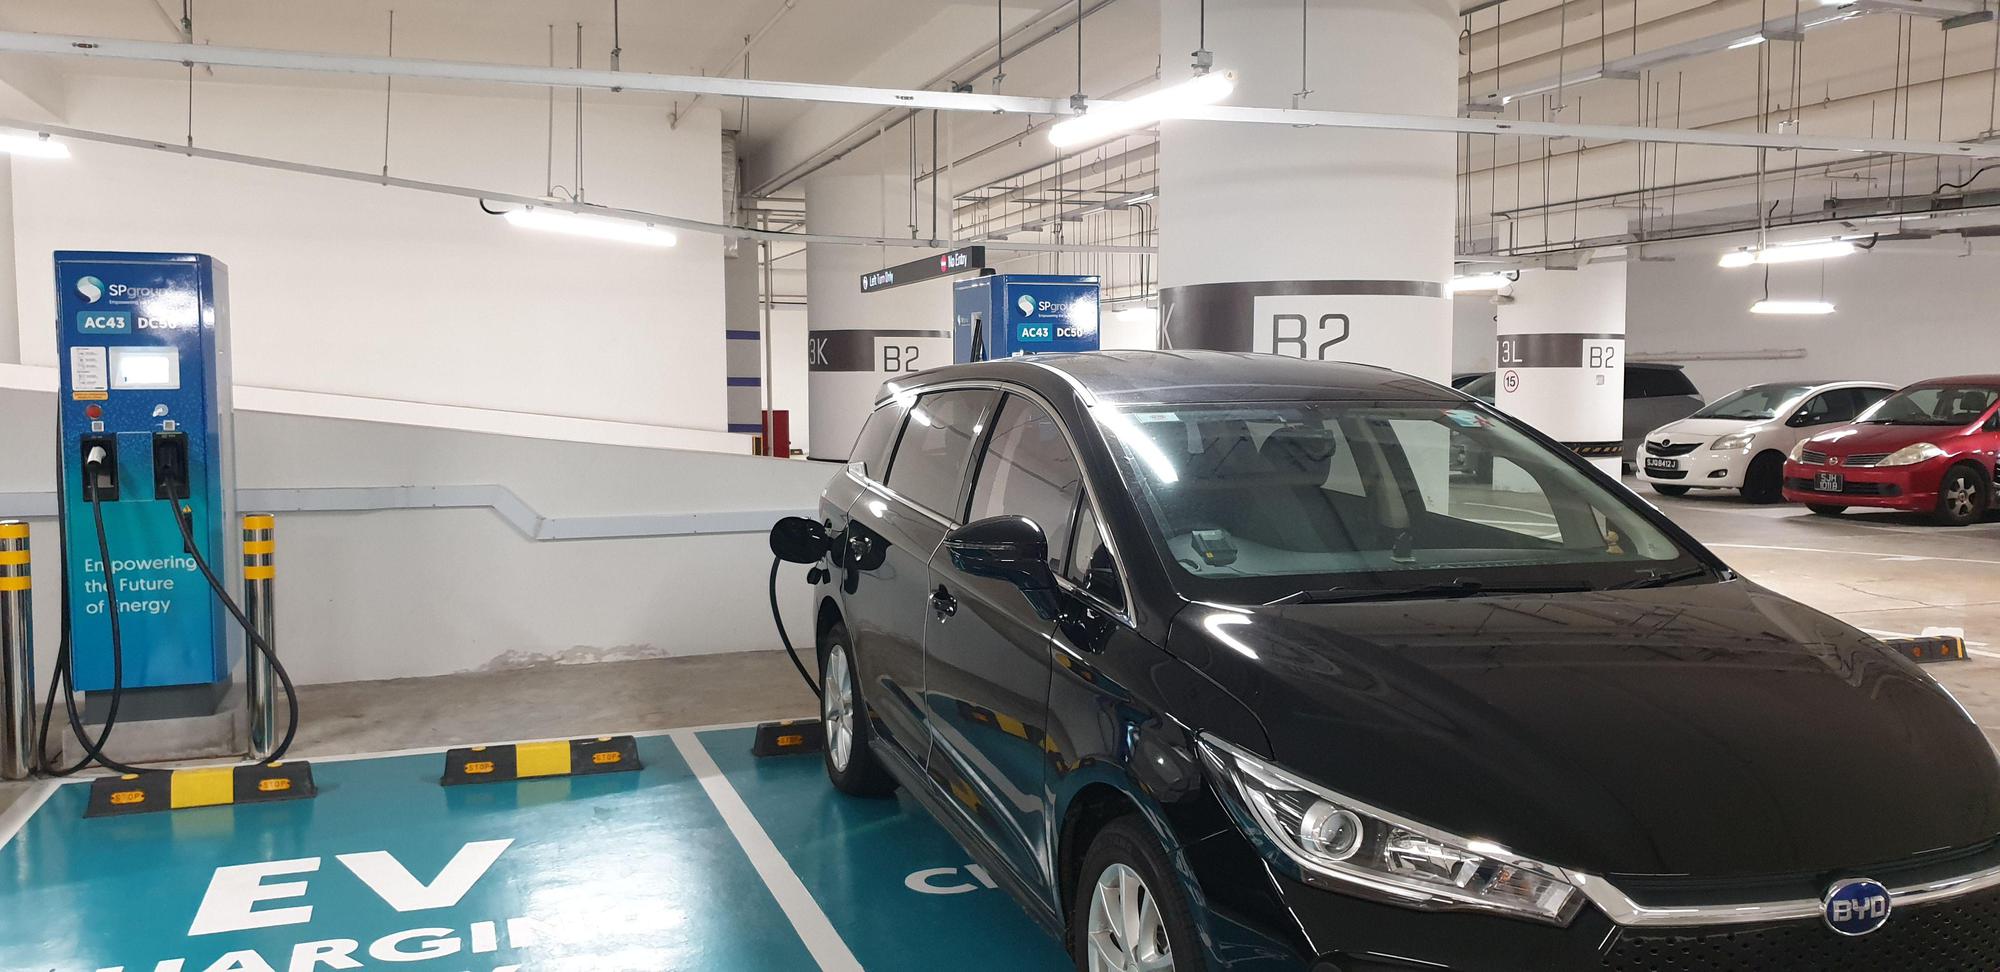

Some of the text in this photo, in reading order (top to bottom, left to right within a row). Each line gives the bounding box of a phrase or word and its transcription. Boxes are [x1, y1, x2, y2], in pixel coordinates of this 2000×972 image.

[955, 253, 967, 267] Entry
[1038, 301, 1075, 313] SPgro
[84, 317, 126, 329] AC43
[1021, 327, 1083, 338] AC43 DC50
[1273, 313, 1350, 360] B2
[809, 338, 828, 365] 3K
[1502, 340, 1523, 363] 3L
[1589, 346, 1615, 368] B2
[883, 346, 919, 372] B2
[1505, 375, 1516, 387] 15
[1820, 473, 1837, 482] SJH
[120, 578, 174, 592] Future
[86, 599, 171, 615] of nergy
[468, 763, 490, 772] STOP
[261, 779, 288, 789] STOP
[115, 792, 140, 802] STOP
[188, 838, 514, 936] EV
[1833, 895, 1885, 921] BYD
